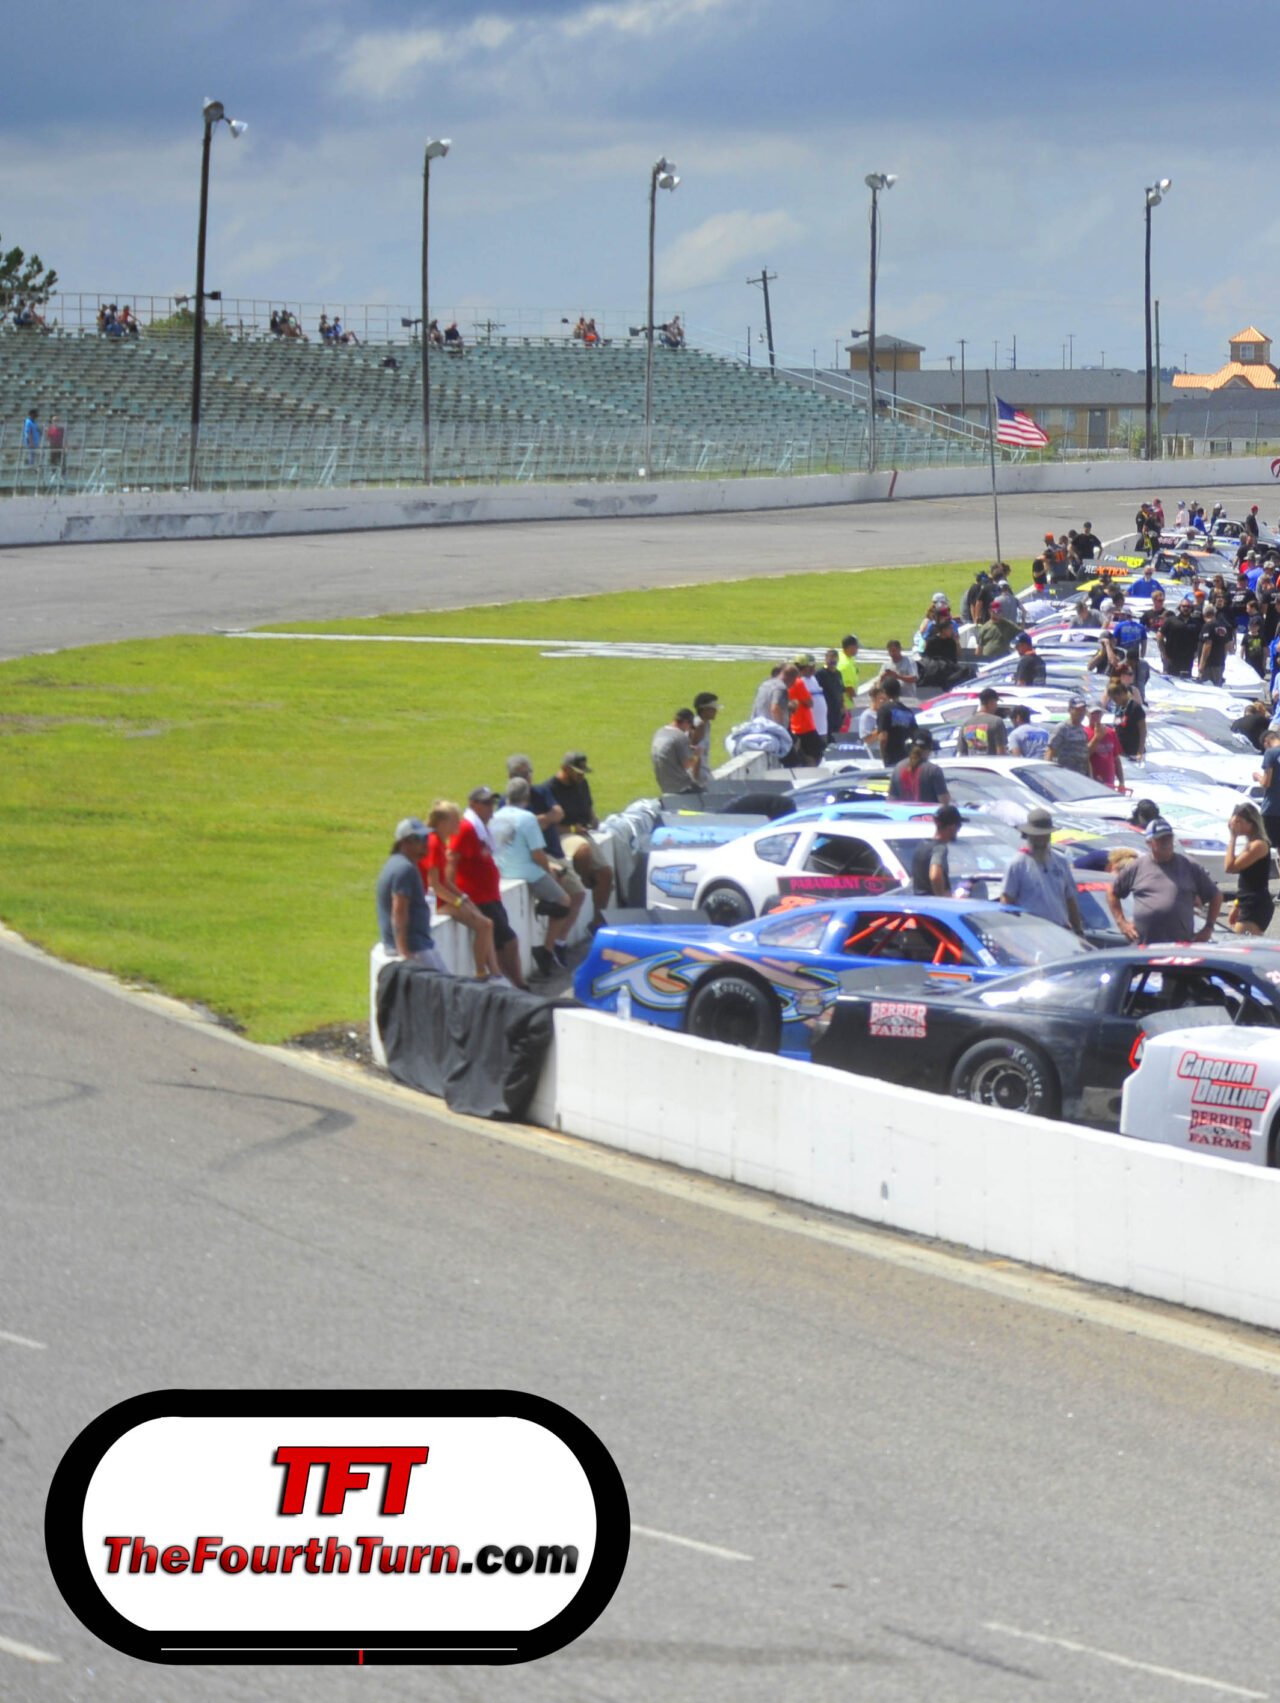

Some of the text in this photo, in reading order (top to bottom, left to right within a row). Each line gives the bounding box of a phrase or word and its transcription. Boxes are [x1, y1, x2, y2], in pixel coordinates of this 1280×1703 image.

[1084, 565, 1128, 576] REACTION
[790, 876, 861, 890] PARAMOUNT
[870, 1001, 928, 1025] BERRIER
[869, 1024, 927, 1039] FARMS
[1178, 1051, 1257, 1085] CAROLINA
[1192, 1079, 1270, 1111] DRILLING
[1190, 1110, 1253, 1139] BERRIER
[1189, 1133, 1252, 1151] FARMS
